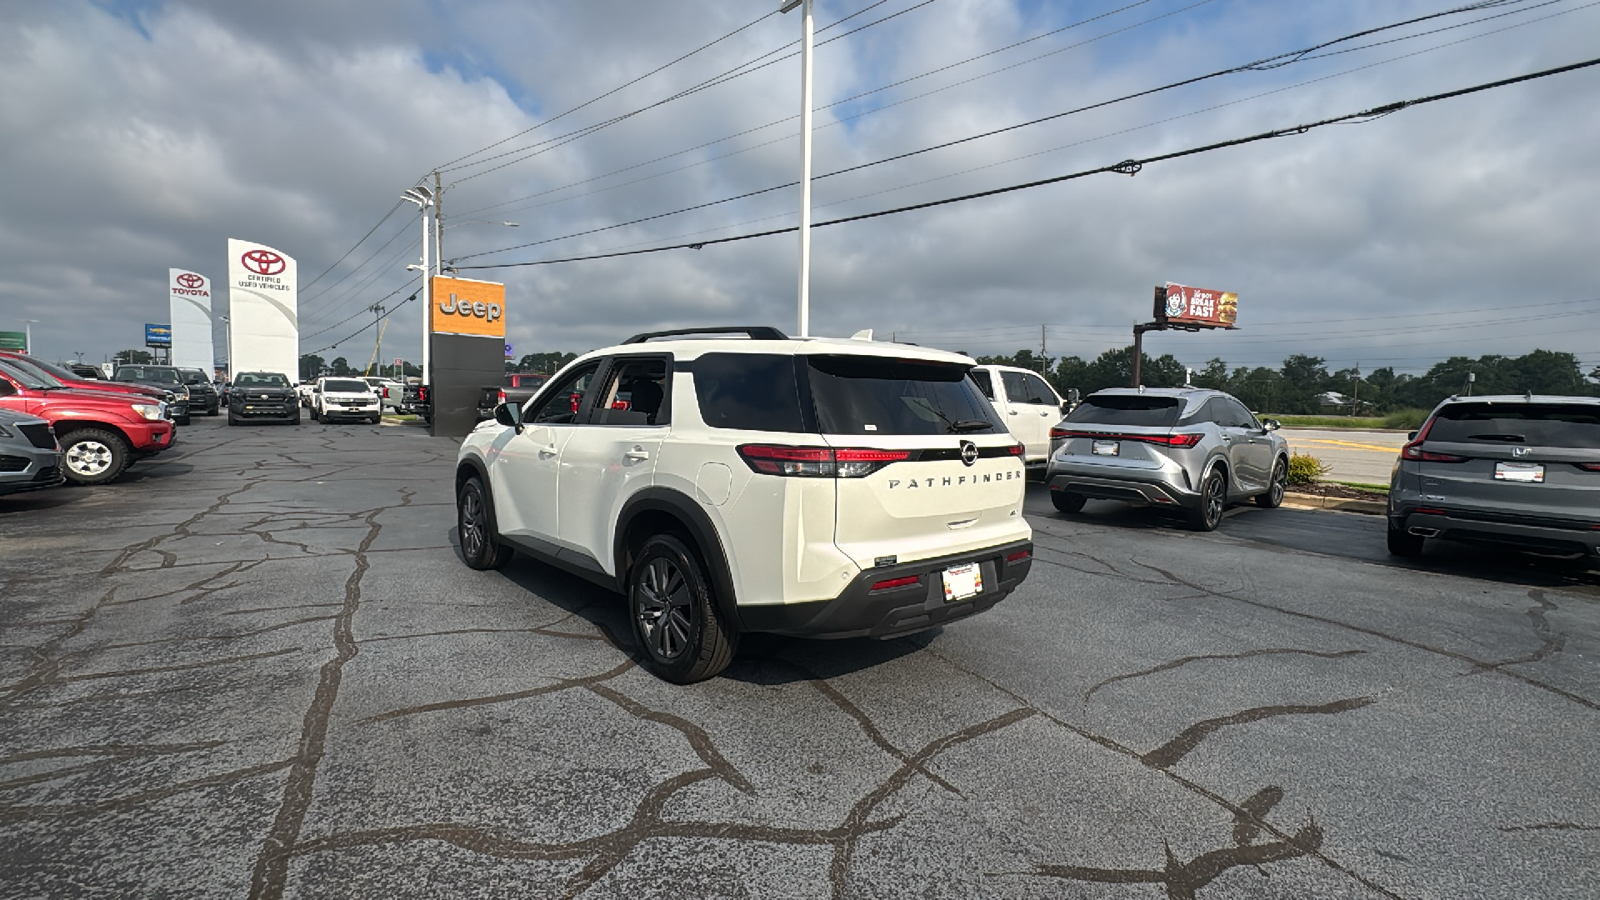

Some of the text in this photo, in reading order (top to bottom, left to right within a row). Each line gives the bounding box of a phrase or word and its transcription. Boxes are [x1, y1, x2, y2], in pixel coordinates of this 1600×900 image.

[248, 275, 281, 284] CERTIFIED
[172, 288, 209, 297] TOYOTA
[259, 283, 290, 291] VEHICLES
[439, 293, 502, 323] Jeep
[1189, 305, 1214, 318] FAST
[889, 470, 1021, 489] PATHFINDER
